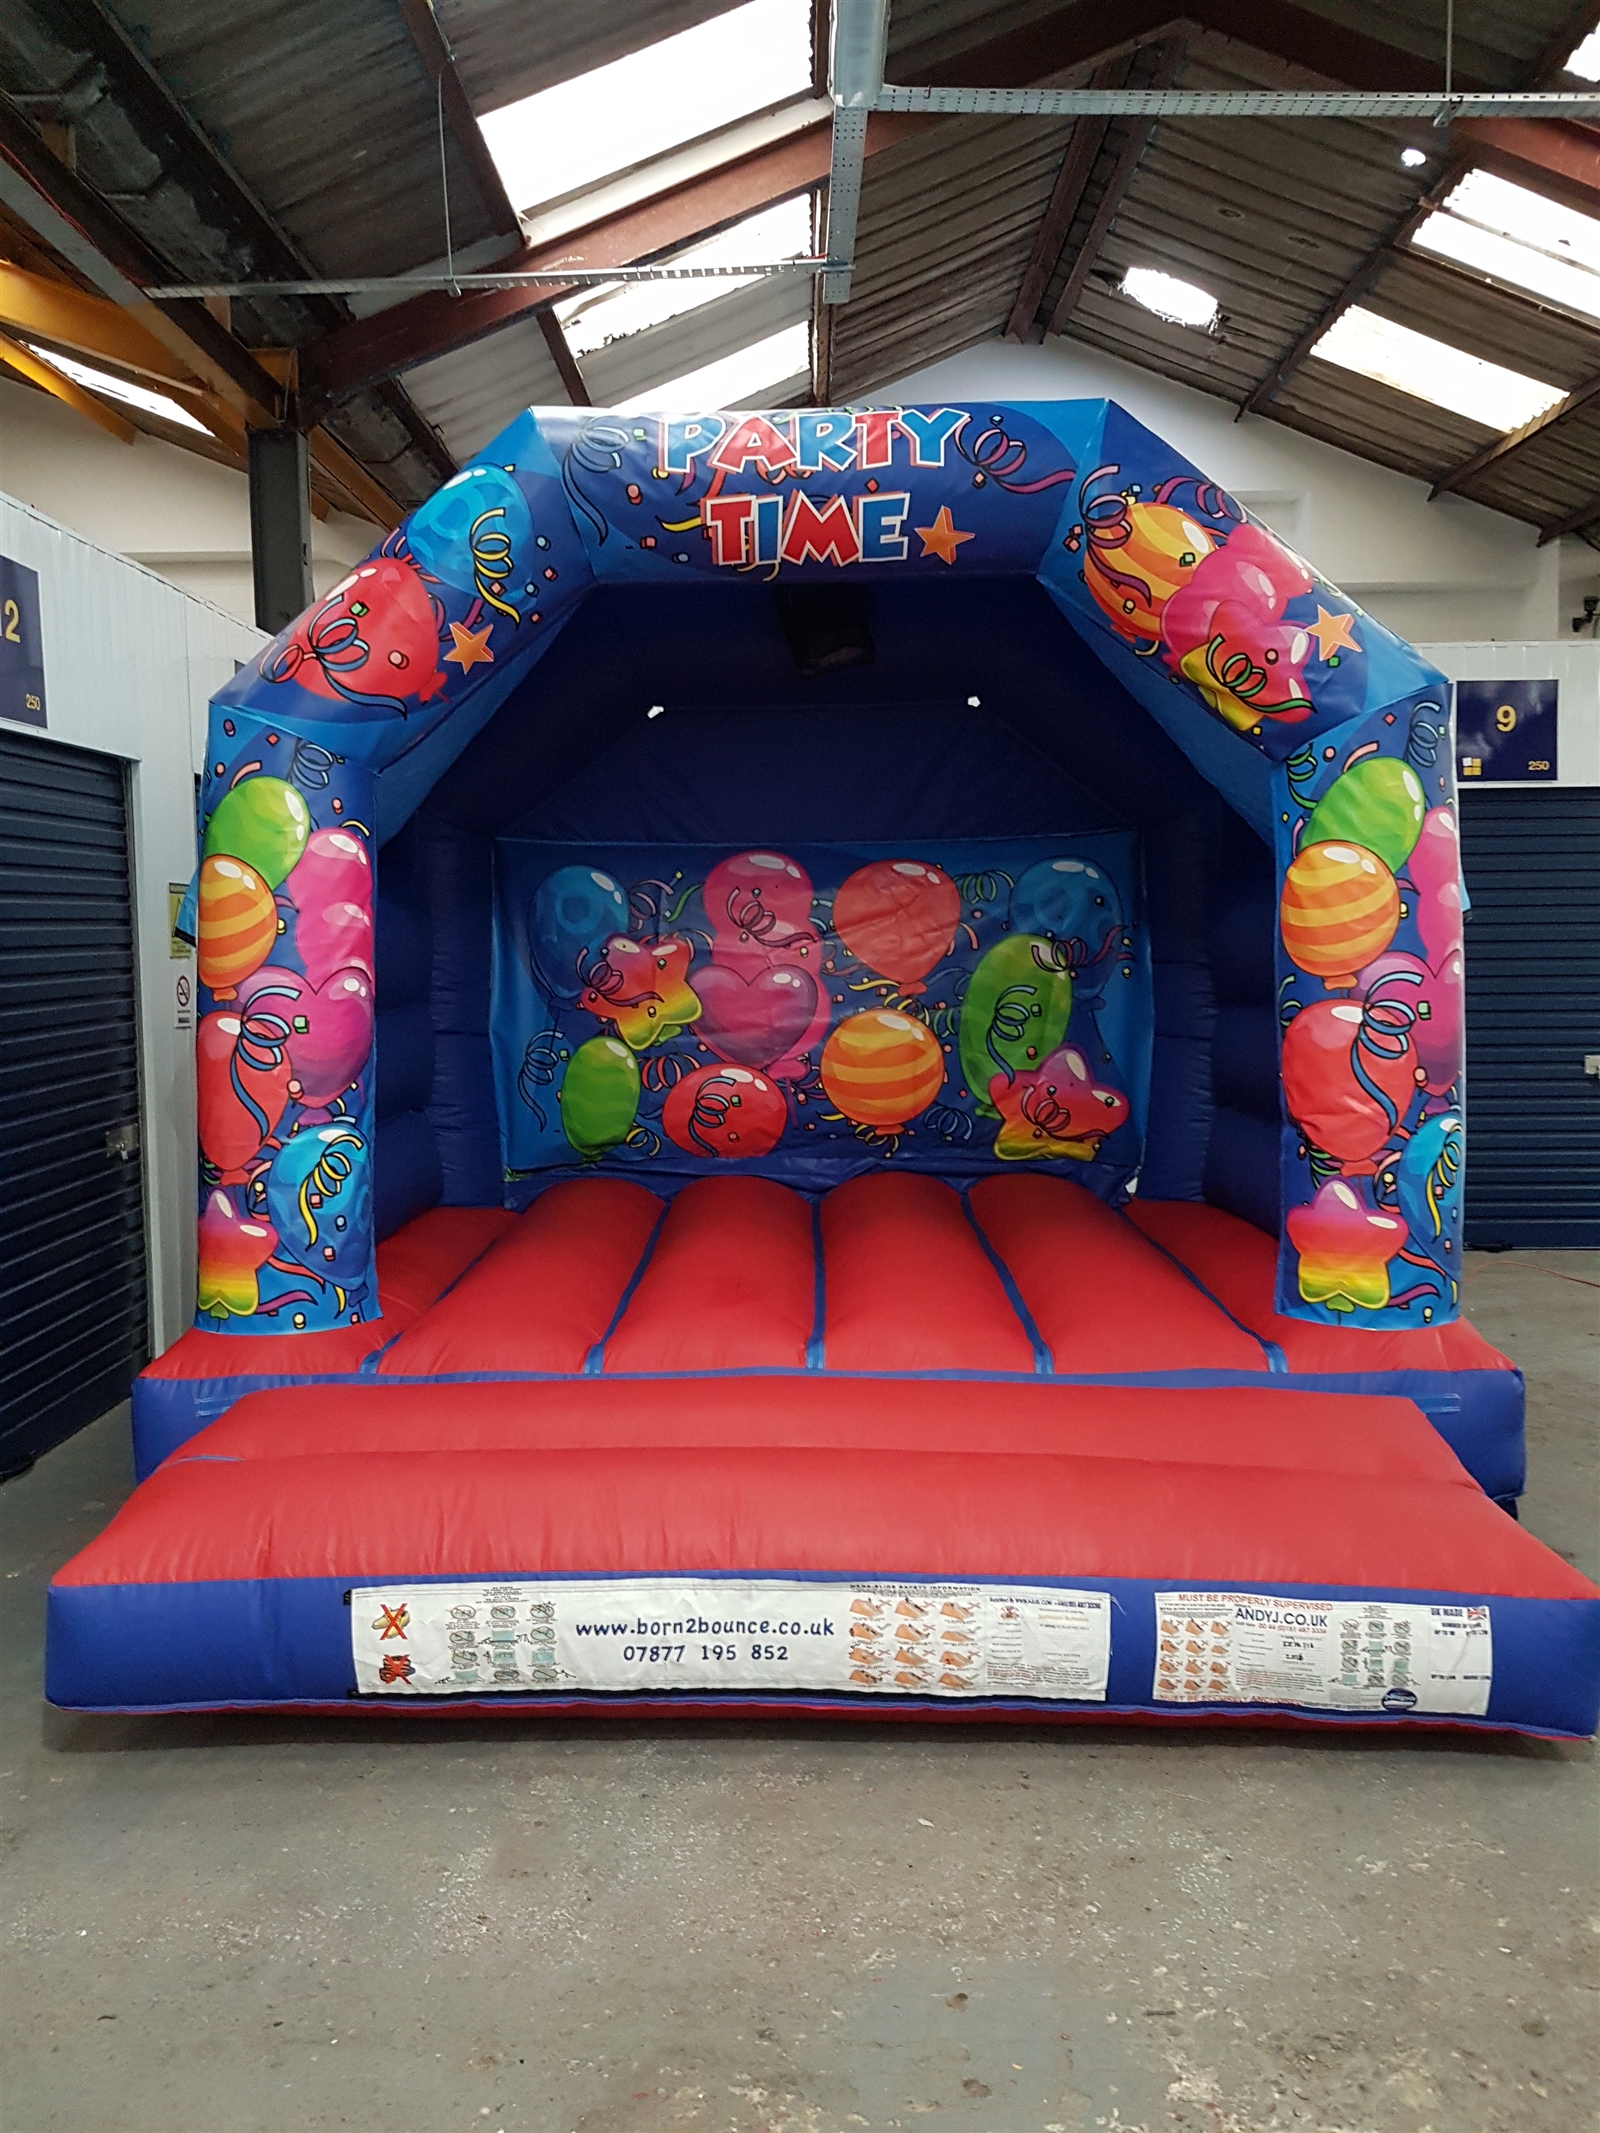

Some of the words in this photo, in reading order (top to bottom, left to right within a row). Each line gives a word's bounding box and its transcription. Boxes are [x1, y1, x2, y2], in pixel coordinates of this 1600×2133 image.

[658, 408, 970, 474] PARTY
[700, 489, 911, 568] TIME
[26, 694, 41, 711] 250
[1496, 704, 1517, 732] 9
[1528, 760, 1550, 771] 250
[1178, 1593, 1204, 1602] MUST
[1207, 1594, 1220, 1603] BE
[1222, 1595, 1270, 1607] PROPERLY
[1273, 1600, 1334, 1611] SUPERVISED
[576, 1617, 835, 1636] www.born2bounce.co.uk
[1235, 1607, 1329, 1627] ANDYJ.CO.UK
[623, 1645, 686, 1662] 07877
[701, 1644, 737, 1661] 195
[751, 1644, 789, 1661] 852
